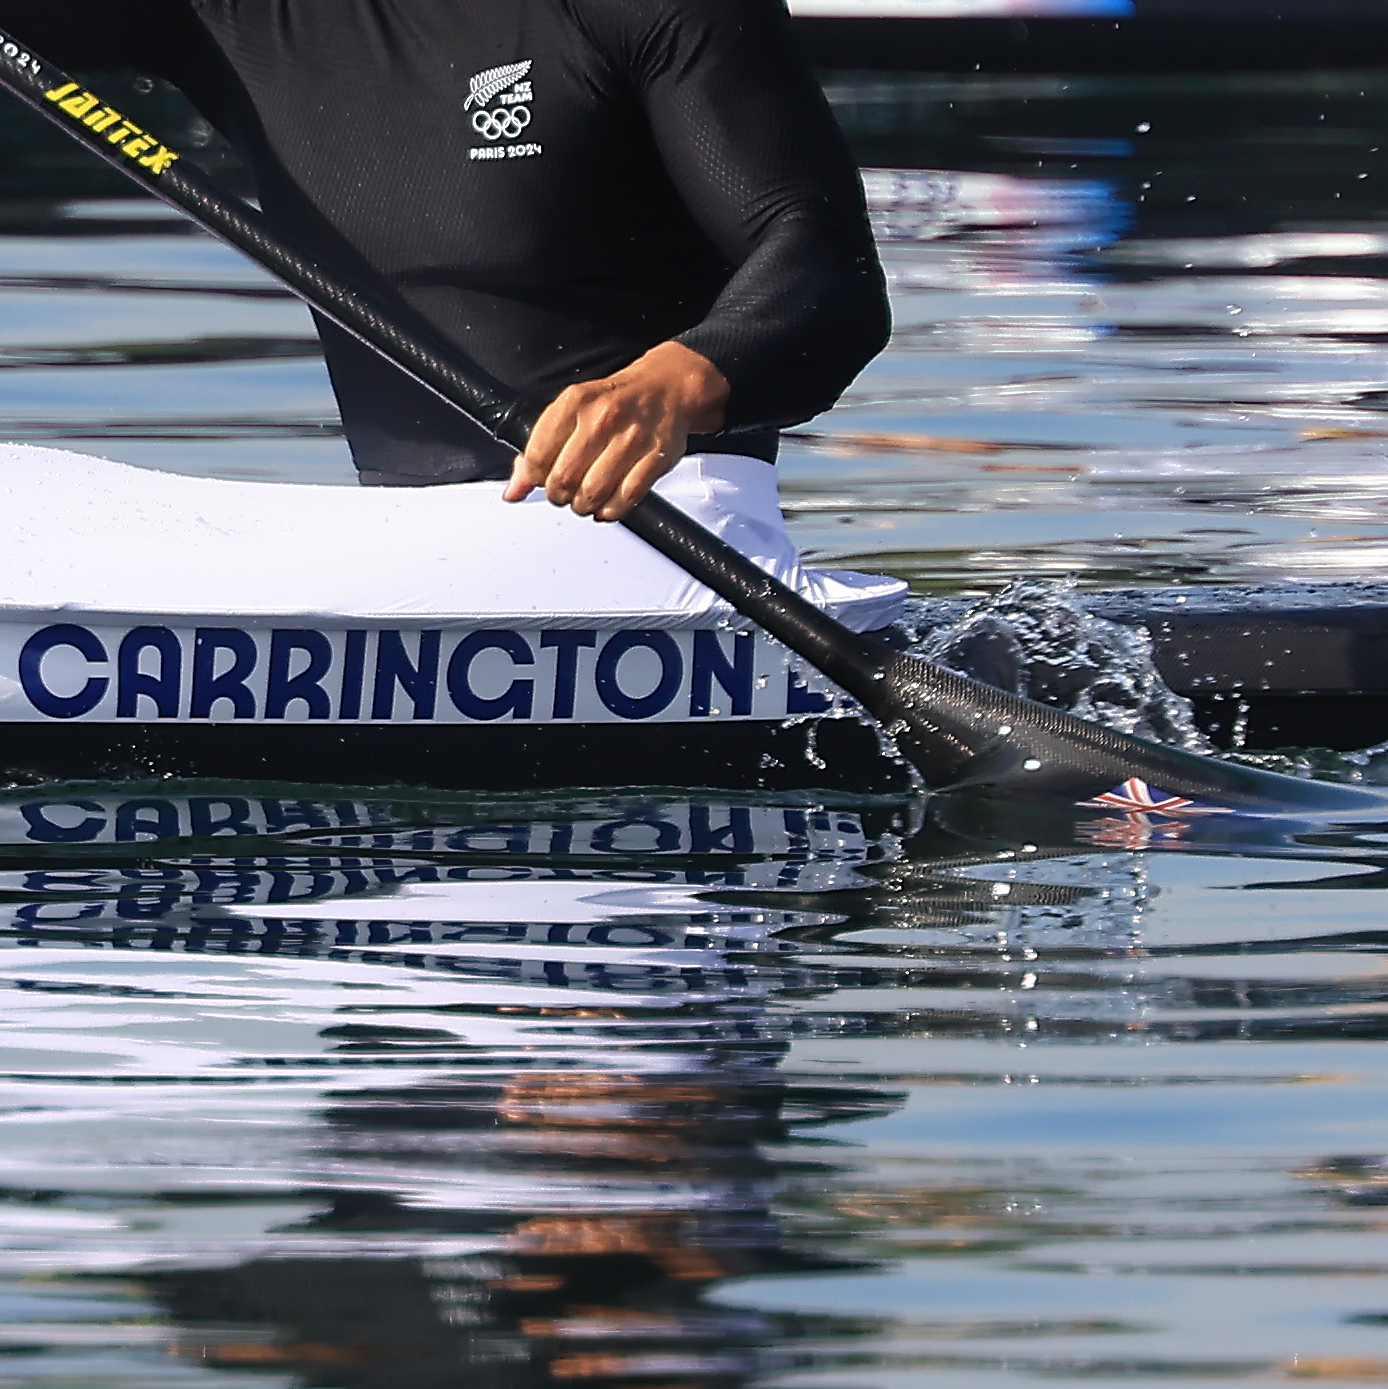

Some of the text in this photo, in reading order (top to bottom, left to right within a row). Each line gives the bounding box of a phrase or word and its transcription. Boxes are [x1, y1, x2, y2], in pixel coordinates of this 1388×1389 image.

[514, 81, 533, 94] NZ
[499, 92, 533, 105] TEAM
[470, 143, 542, 160] PARIS 2024
[18, 622, 754, 720] CARRINGTON
